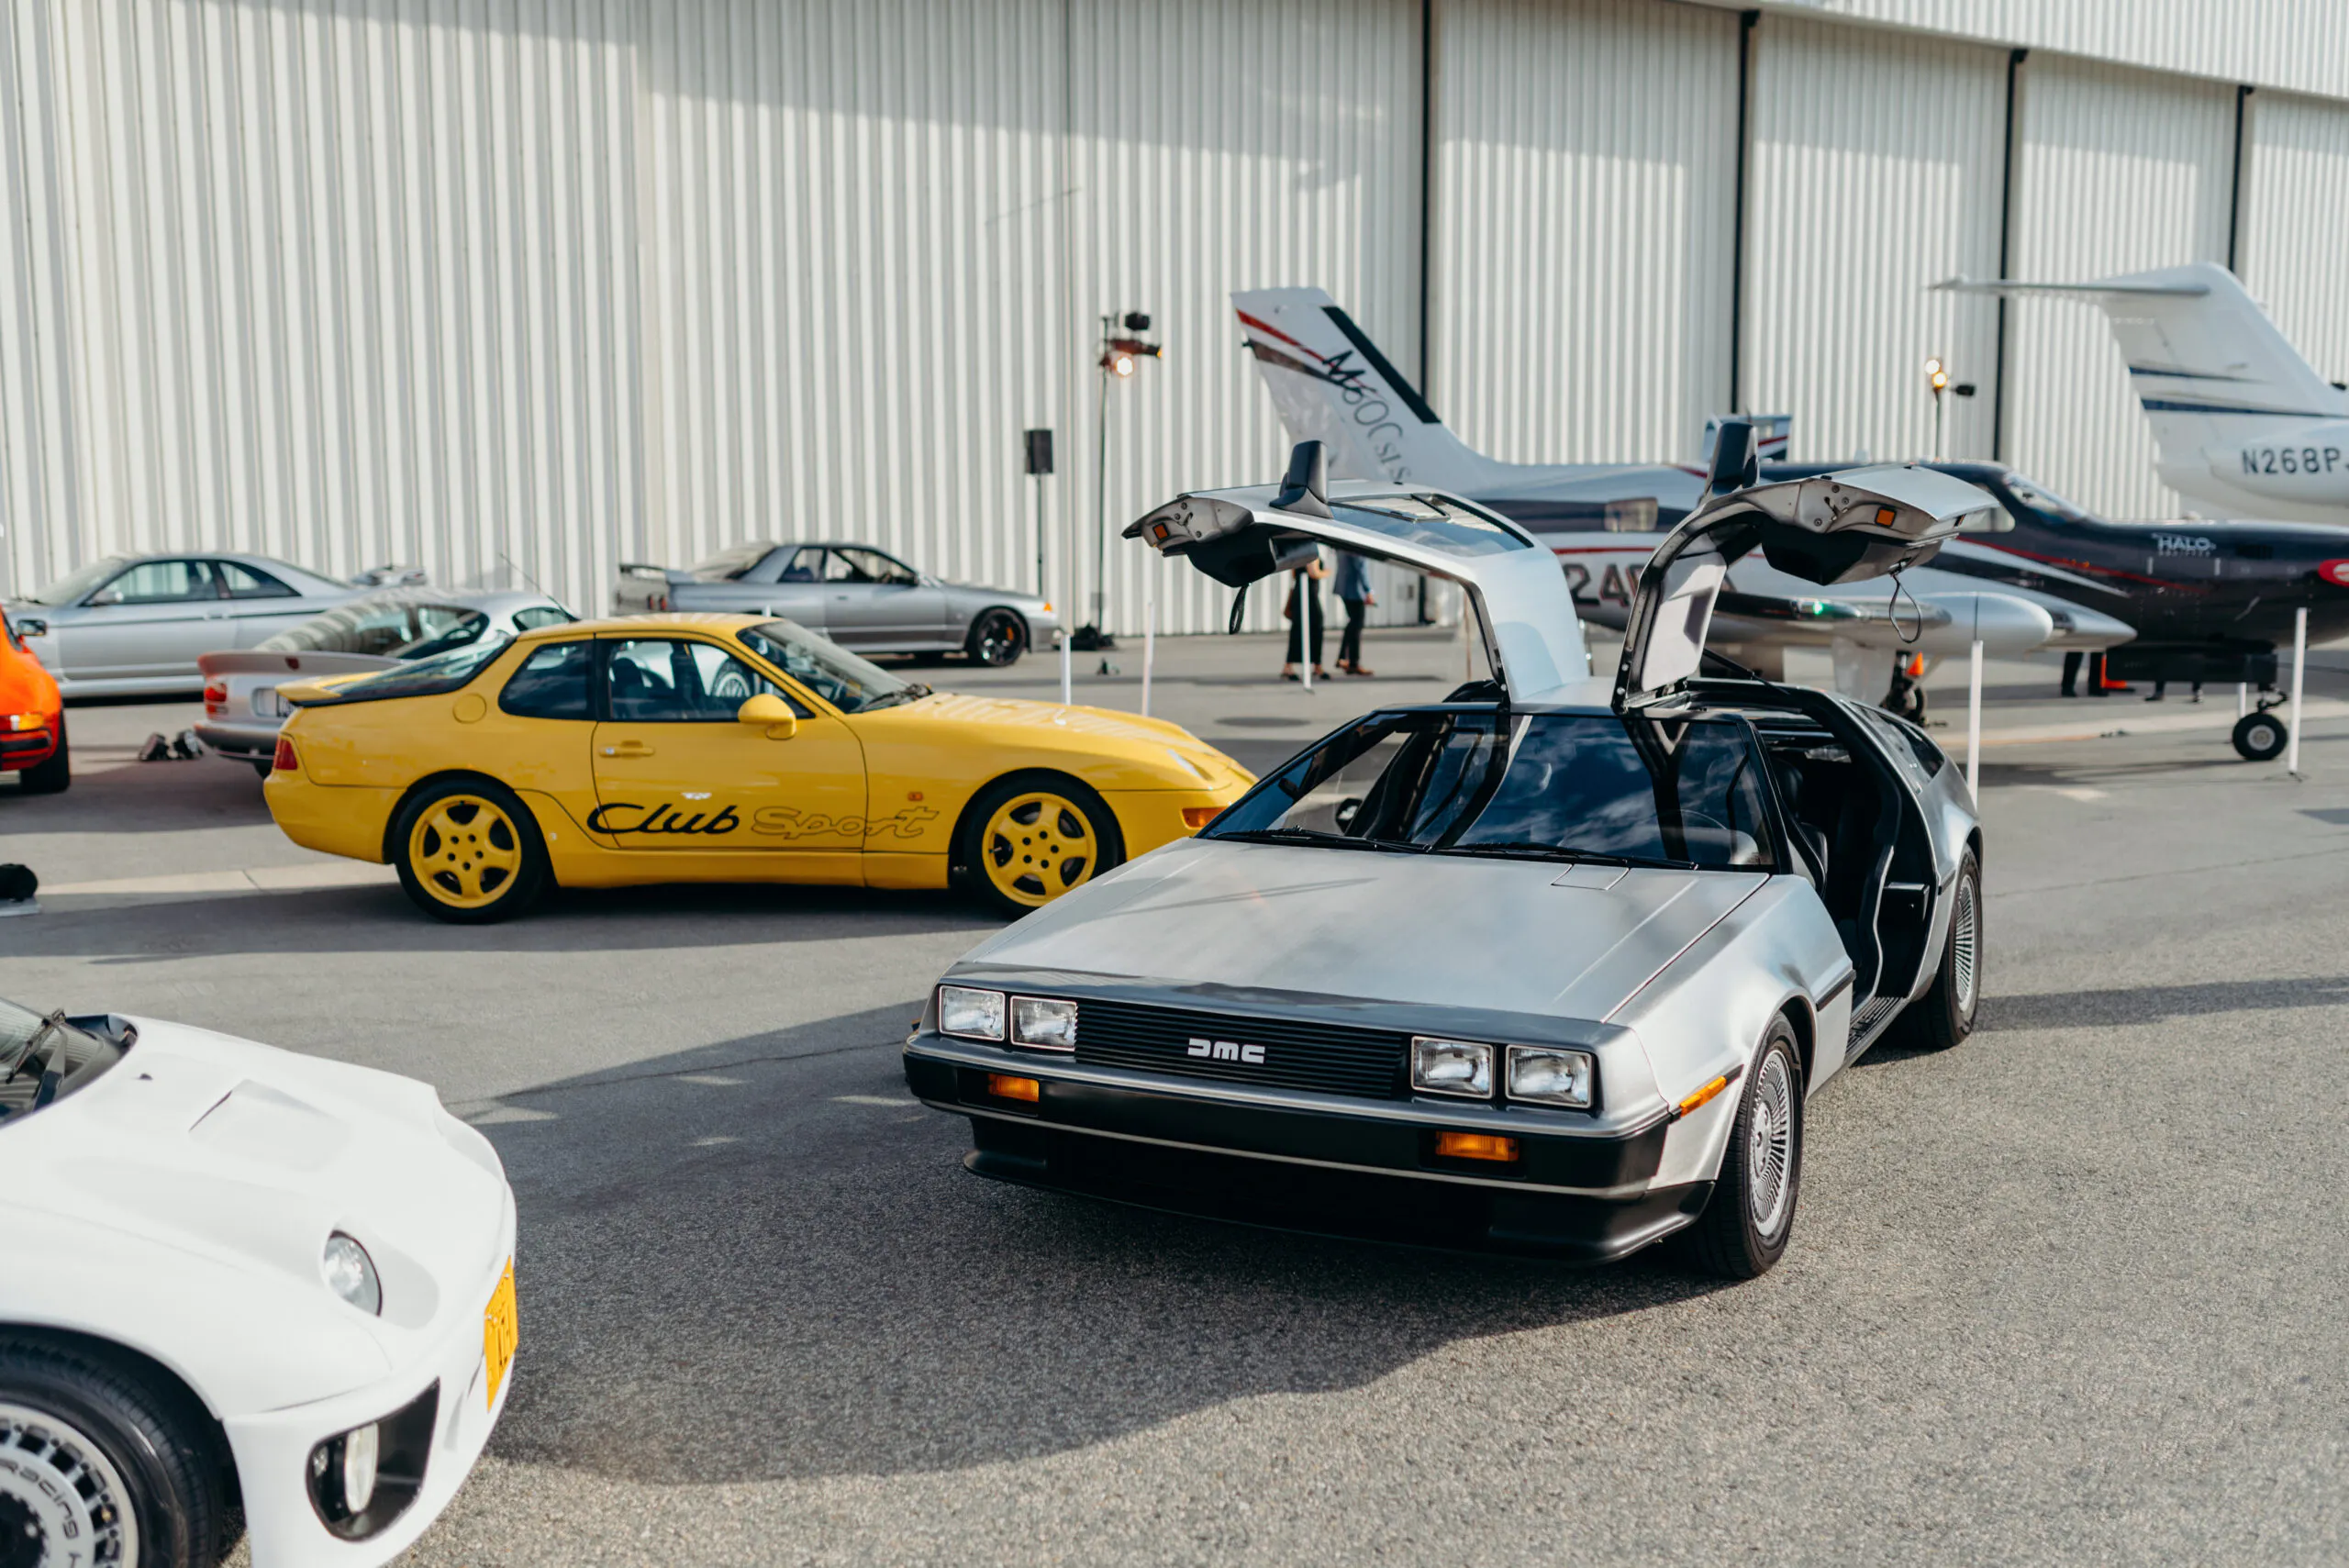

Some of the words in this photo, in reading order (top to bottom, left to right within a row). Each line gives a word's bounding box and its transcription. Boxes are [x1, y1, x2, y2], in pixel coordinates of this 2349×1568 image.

[2242, 447, 2349, 474] N268P
[2157, 537, 2210, 550] HALO
[586, 803, 740, 834] Club
[751, 806, 940, 840] Sport
